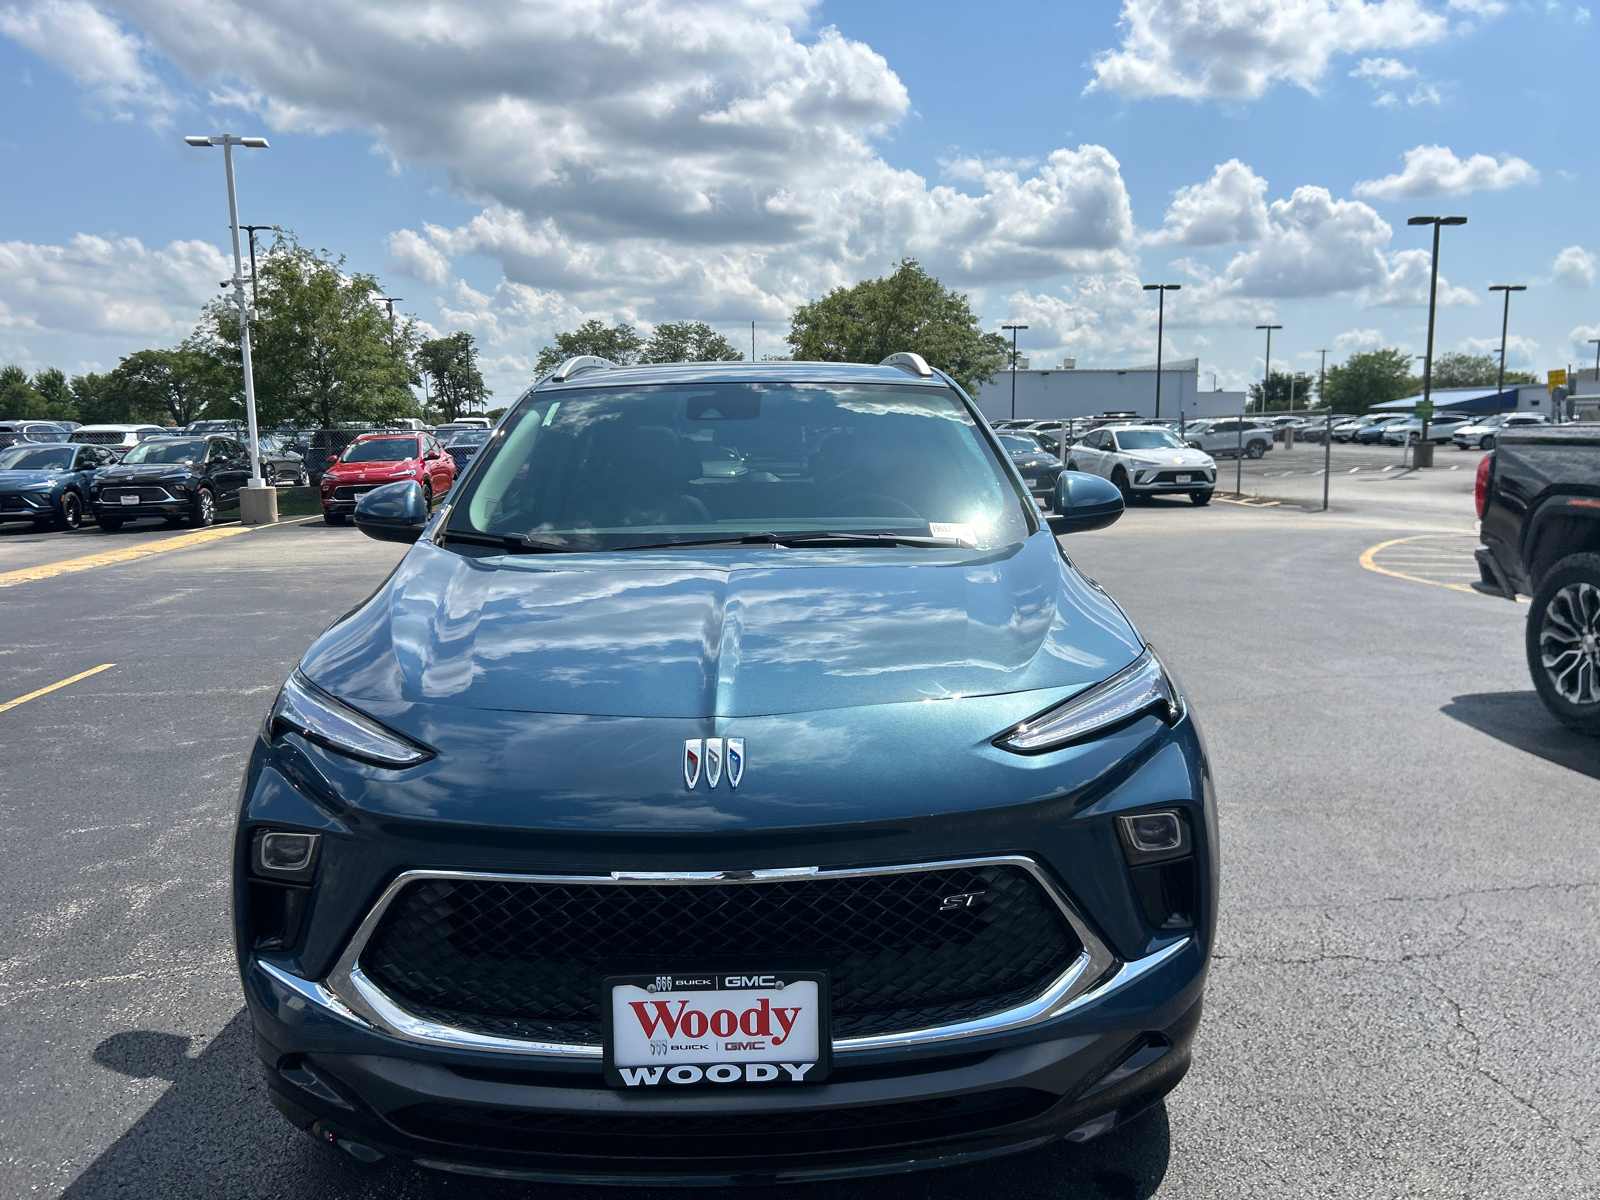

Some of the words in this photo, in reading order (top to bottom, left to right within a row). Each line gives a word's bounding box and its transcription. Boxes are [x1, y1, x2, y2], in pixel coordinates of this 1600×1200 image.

[939, 890, 986, 911] ST
[724, 975, 776, 987] GMC
[627, 998, 803, 1046] Woody
[724, 1041, 766, 1051] GMC
[618, 1063, 815, 1086] WOODY
